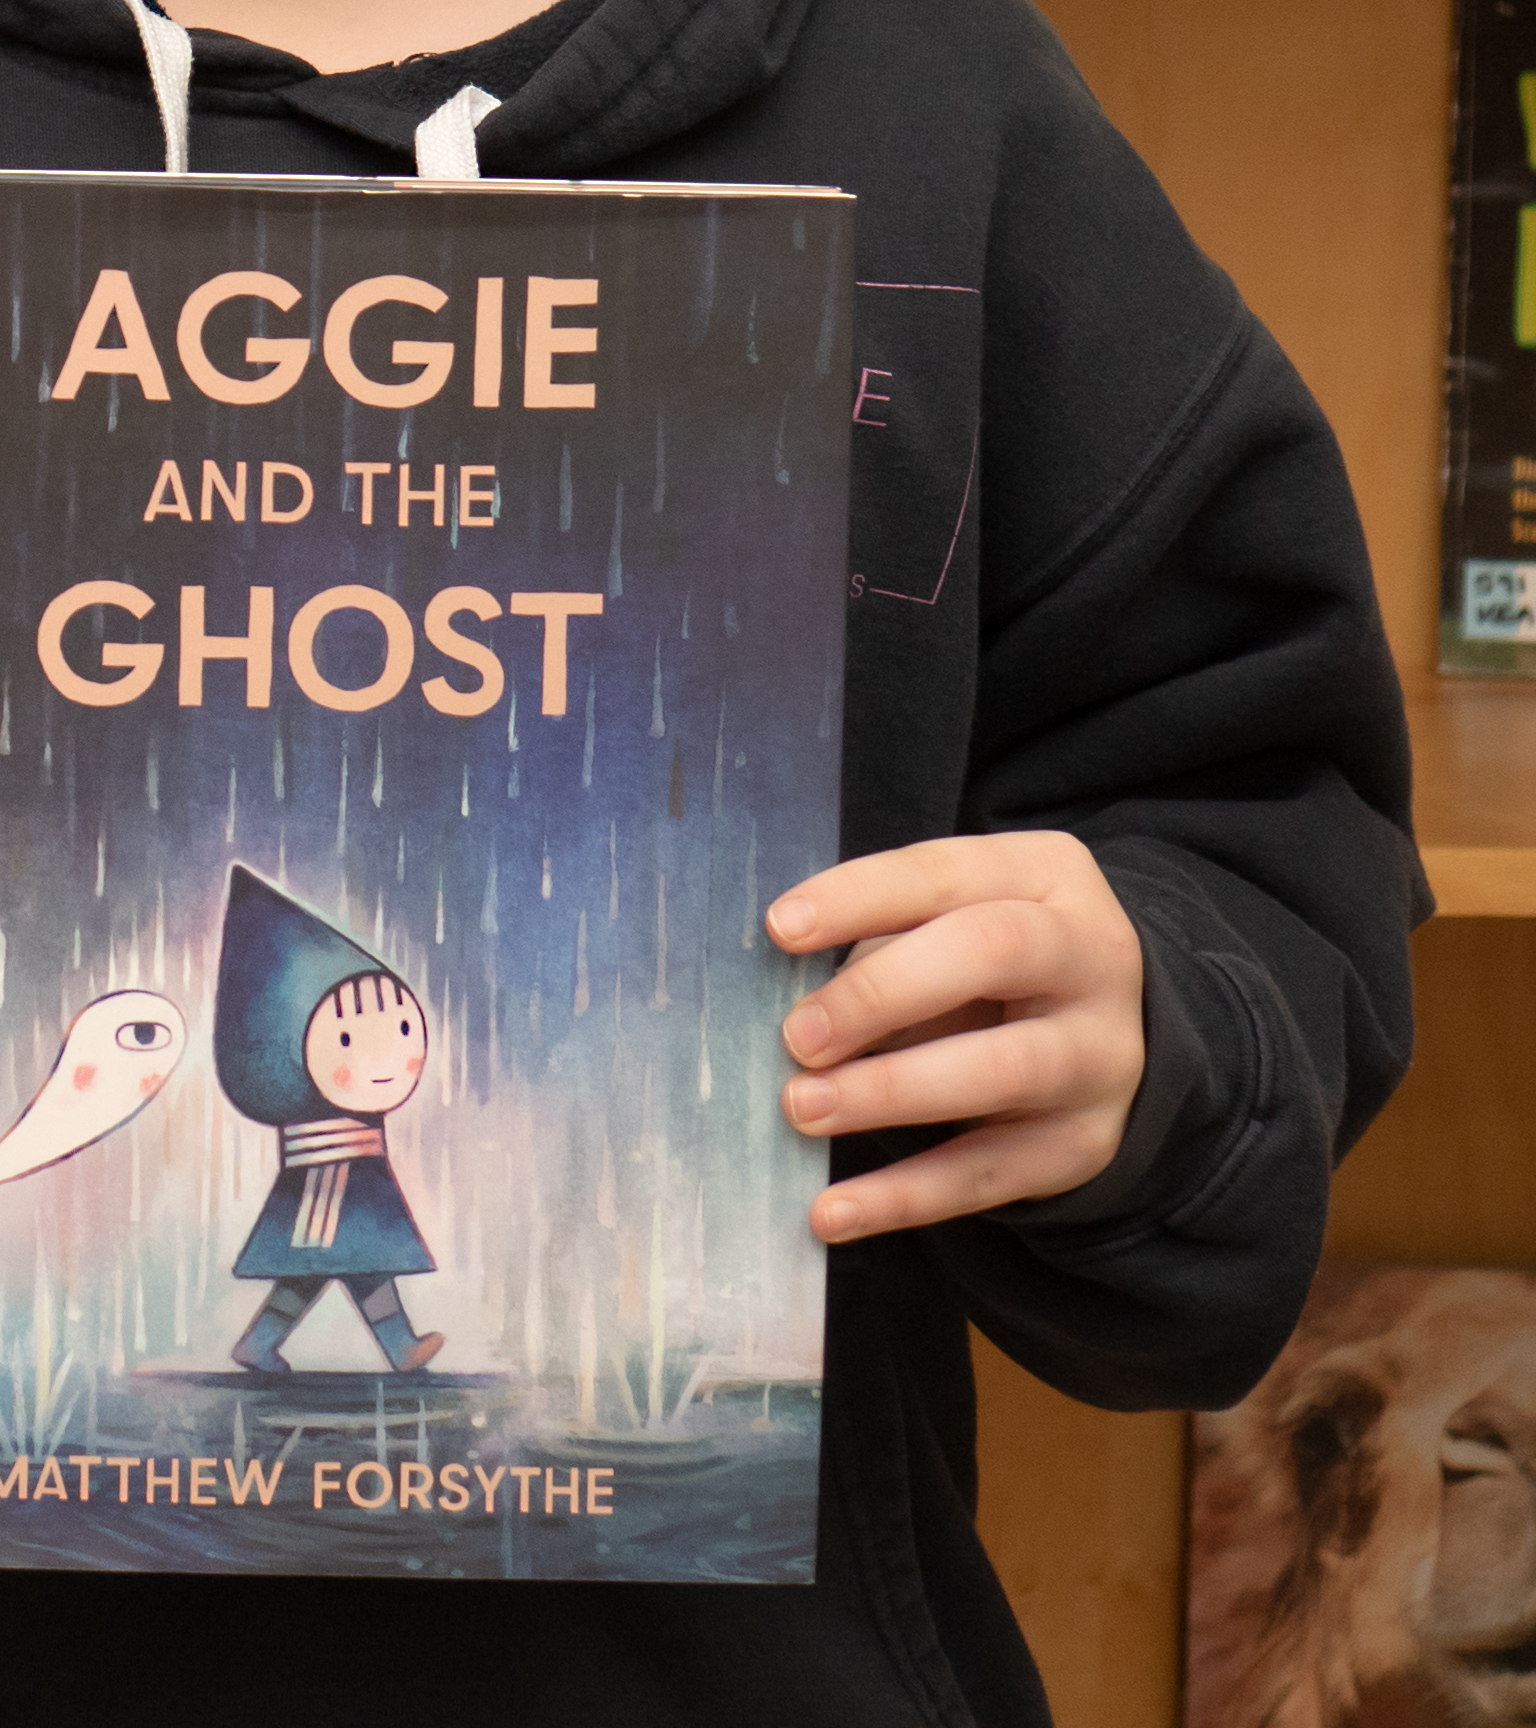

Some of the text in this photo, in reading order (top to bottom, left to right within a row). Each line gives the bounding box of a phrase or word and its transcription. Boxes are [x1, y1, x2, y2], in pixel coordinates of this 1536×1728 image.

[51, 269, 599, 410] AGGIE
[143, 459, 497, 528] AND THE
[36, 580, 604, 718] GHOST
[312, 1461, 616, 1515] FORSYTHE
